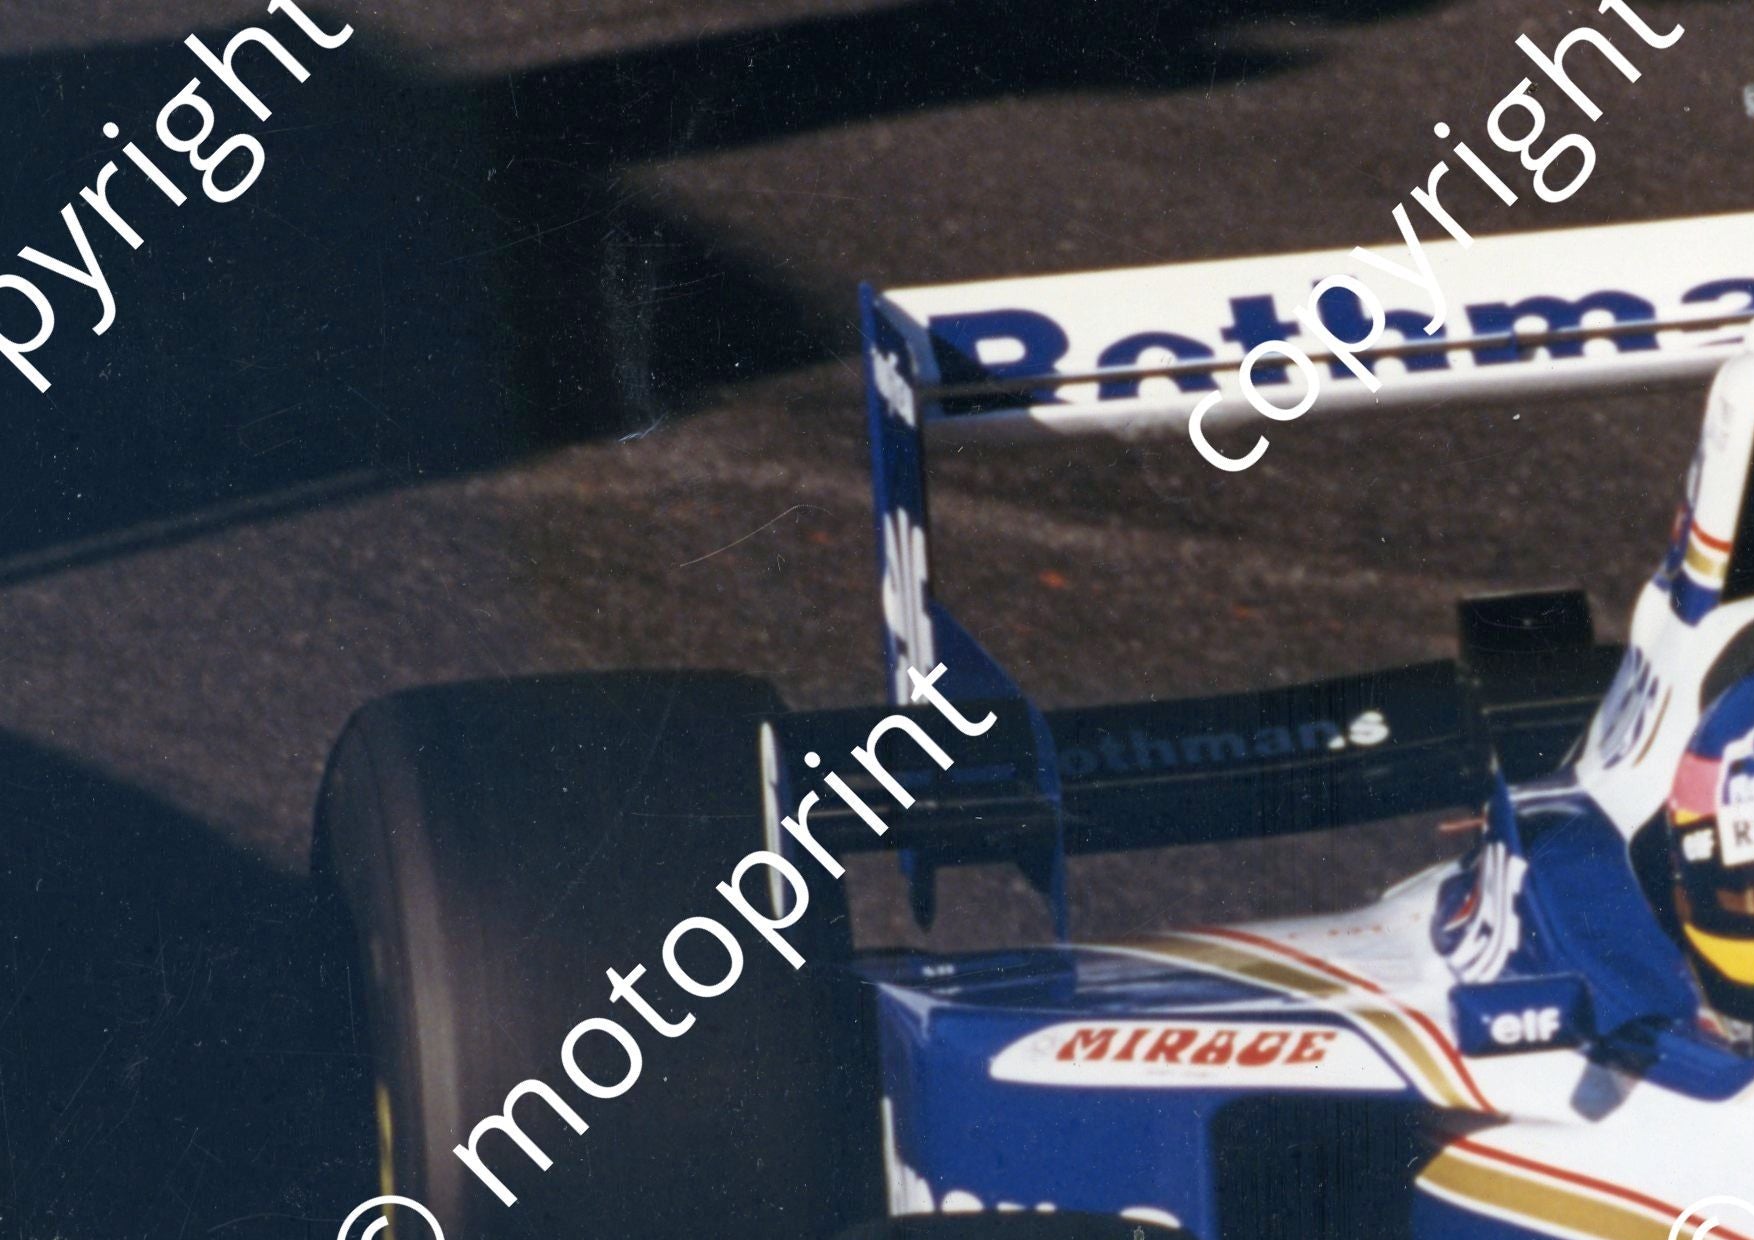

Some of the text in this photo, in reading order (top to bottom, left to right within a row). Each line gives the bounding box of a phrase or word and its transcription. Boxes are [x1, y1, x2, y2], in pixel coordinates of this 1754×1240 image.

[1062, 710, 1390, 776] othmans
[1490, 1007, 1561, 1045] elf
[1056, 1027, 1338, 1067] MIRAGE
